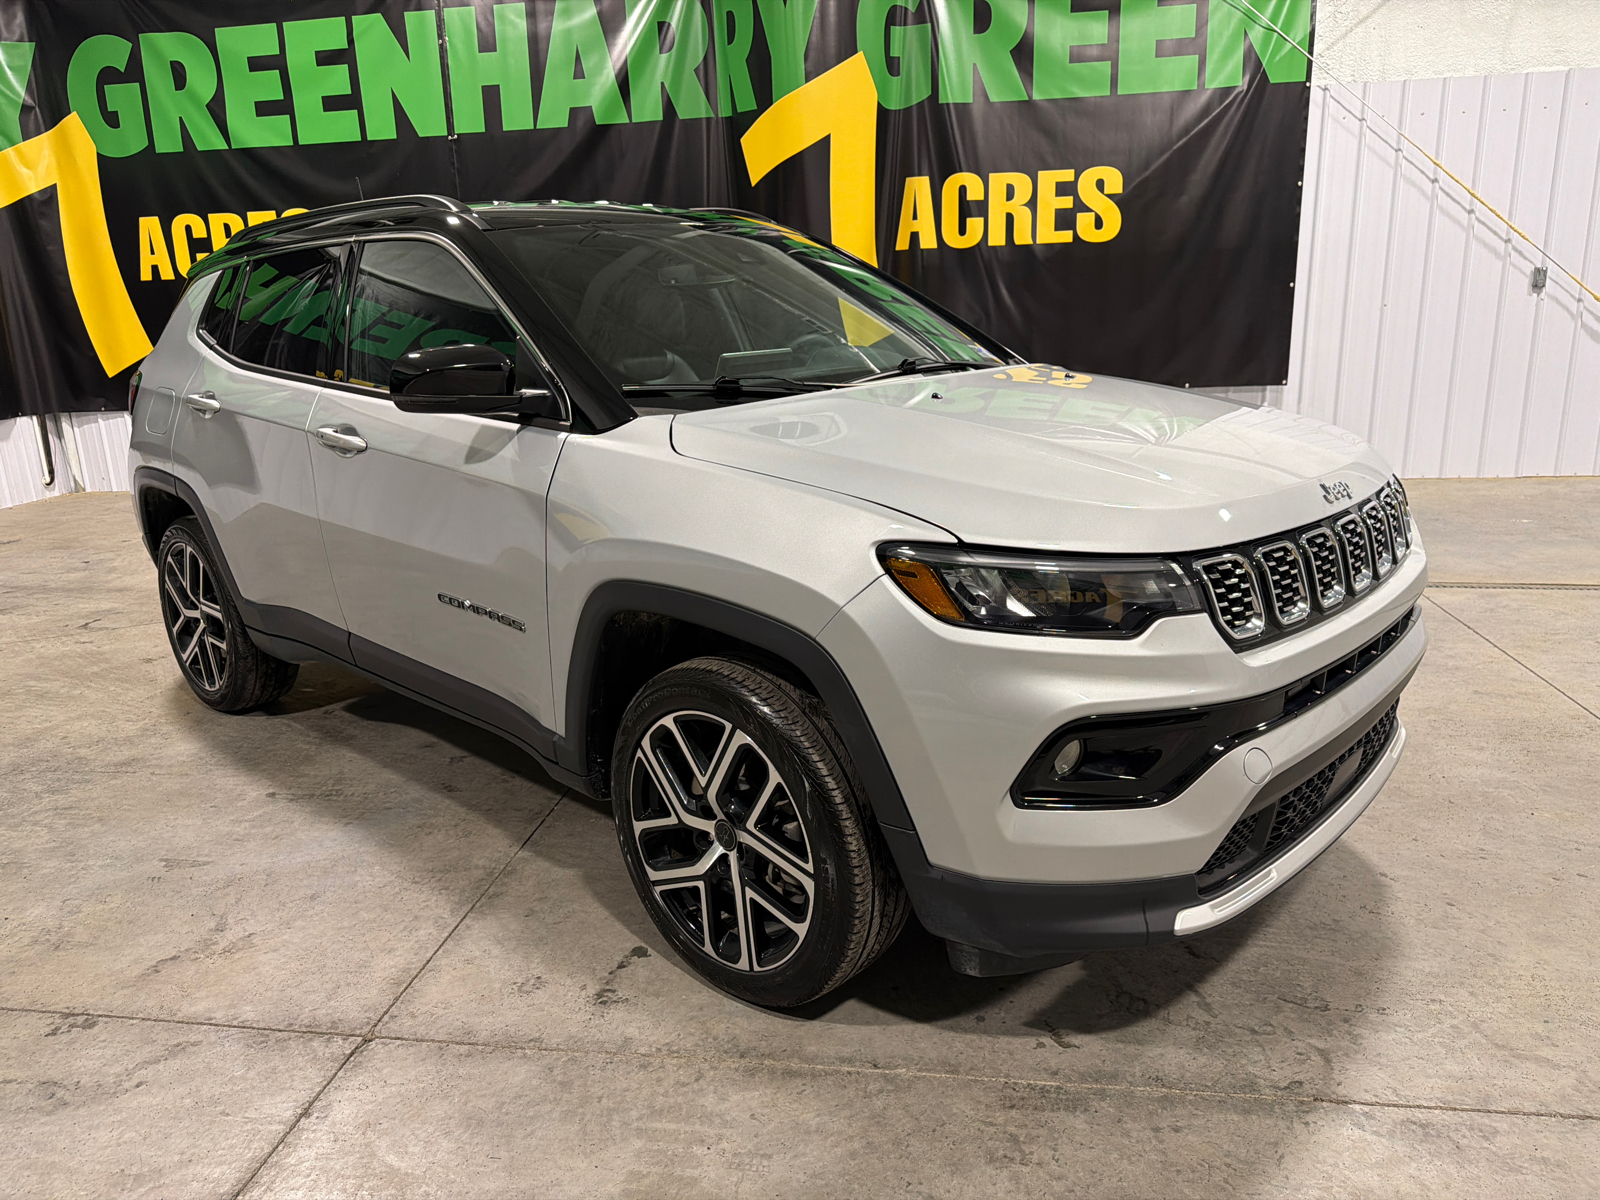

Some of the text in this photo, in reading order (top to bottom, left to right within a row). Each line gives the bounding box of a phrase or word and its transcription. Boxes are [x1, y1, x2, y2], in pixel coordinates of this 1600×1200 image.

[66, 12, 448, 158] GREEN
[442, 0, 1311, 134] HARRY GREEN
[895, 165, 1124, 251] ACRES
[1319, 480, 1353, 505] Jeep
[437, 592, 527, 634] COMPASS
